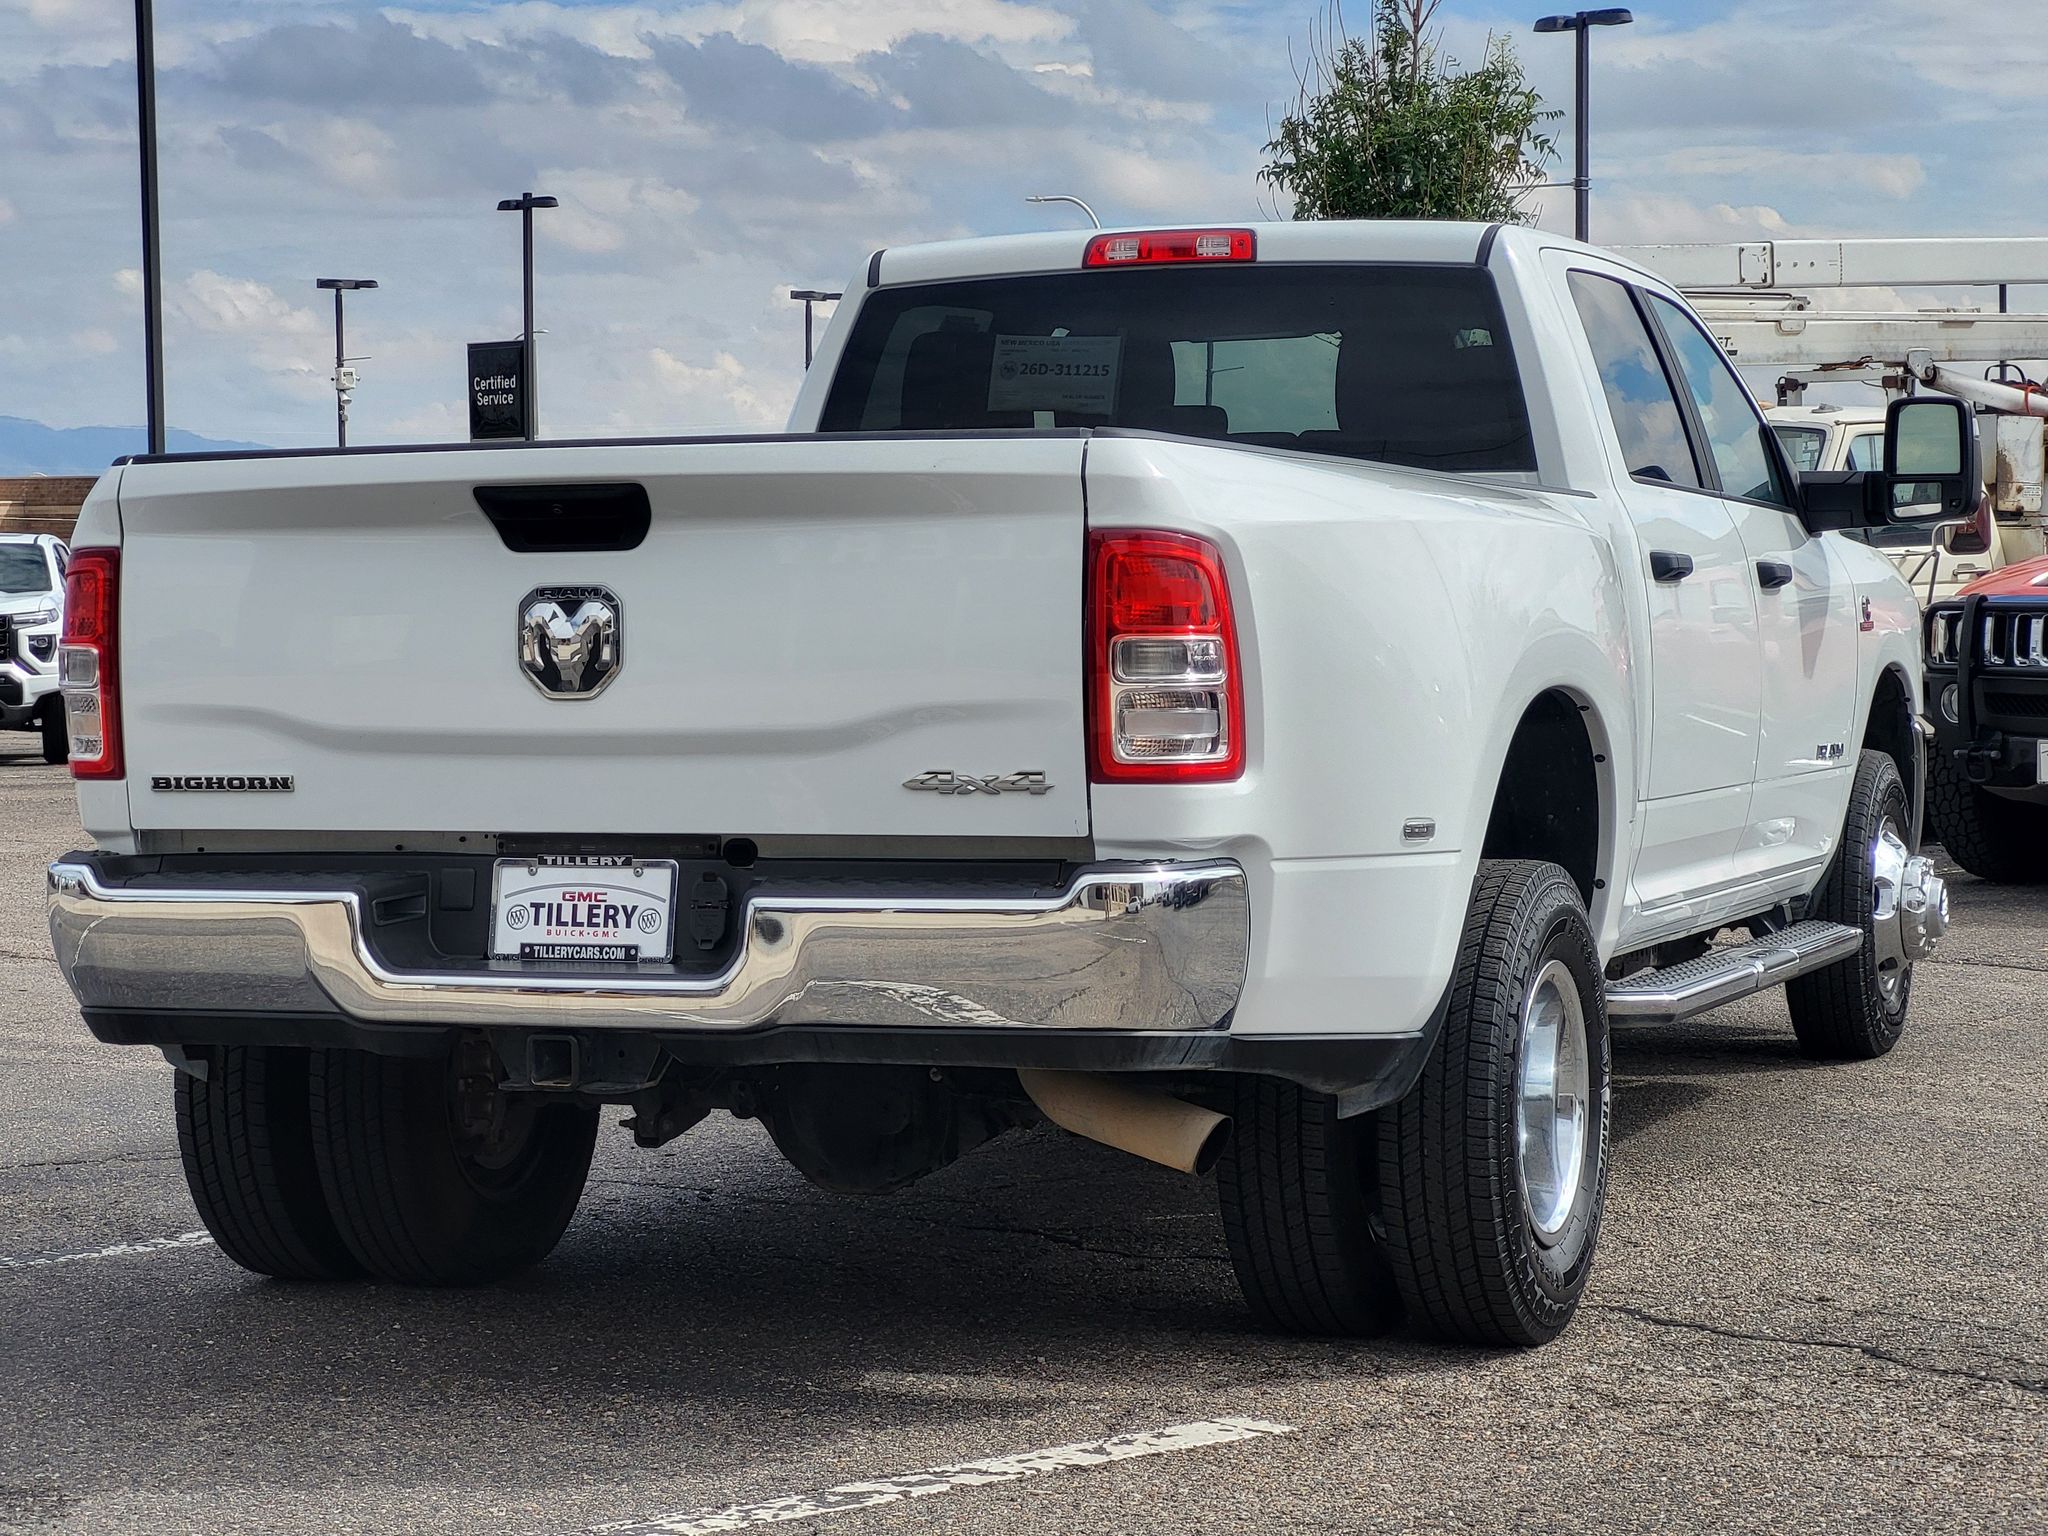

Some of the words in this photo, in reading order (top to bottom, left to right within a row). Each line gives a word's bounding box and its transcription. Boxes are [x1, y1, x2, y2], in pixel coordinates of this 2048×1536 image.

[1020, 362, 1110, 377] 26D-311215
[474, 374, 516, 391] Certified
[477, 391, 514, 406] Service
[538, 588, 602, 599] RAM
[151, 775, 295, 792] BIGHORN
[543, 855, 627, 866] TILLERY
[562, 891, 608, 903] GMC
[530, 902, 639, 929] TILLERY
[533, 945, 626, 960] TILLERYCARS.COM
[1593, 1100, 1610, 1209] TRANSFORCE
